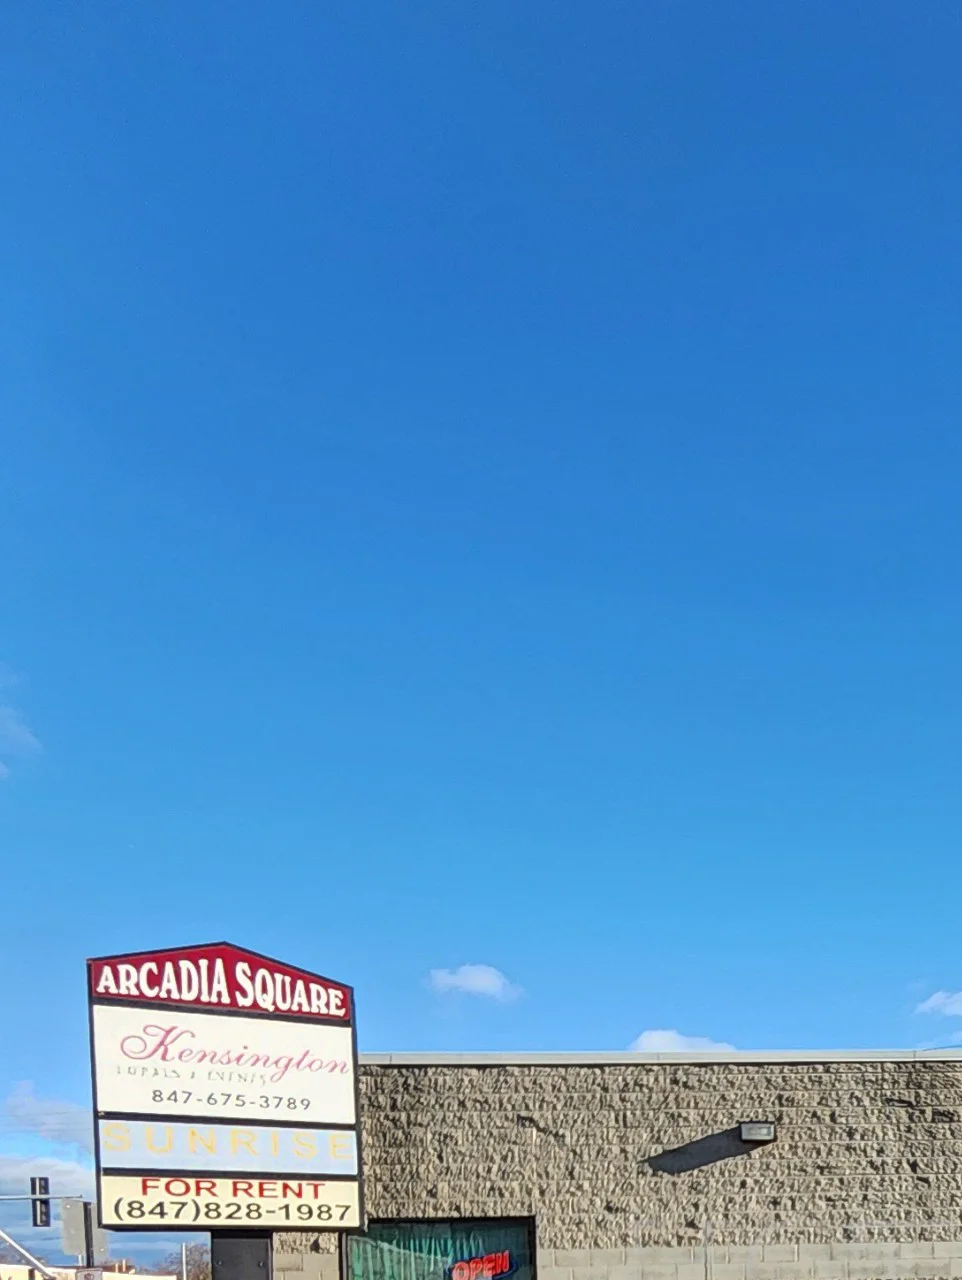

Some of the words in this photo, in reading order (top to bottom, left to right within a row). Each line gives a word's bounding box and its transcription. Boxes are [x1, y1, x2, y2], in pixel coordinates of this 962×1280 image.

[97, 958, 231, 1003] ARCADIA
[235, 962, 346, 1016] SQUARE
[120, 1024, 351, 1083] Kensington
[151, 1088, 311, 1111] 847-675-3789
[102, 1122, 353, 1160] SUNRISE
[141, 1178, 217, 1198] FOR
[231, 1180, 326, 1200] RENT
[113, 1197, 352, 1223] (847)828-1987
